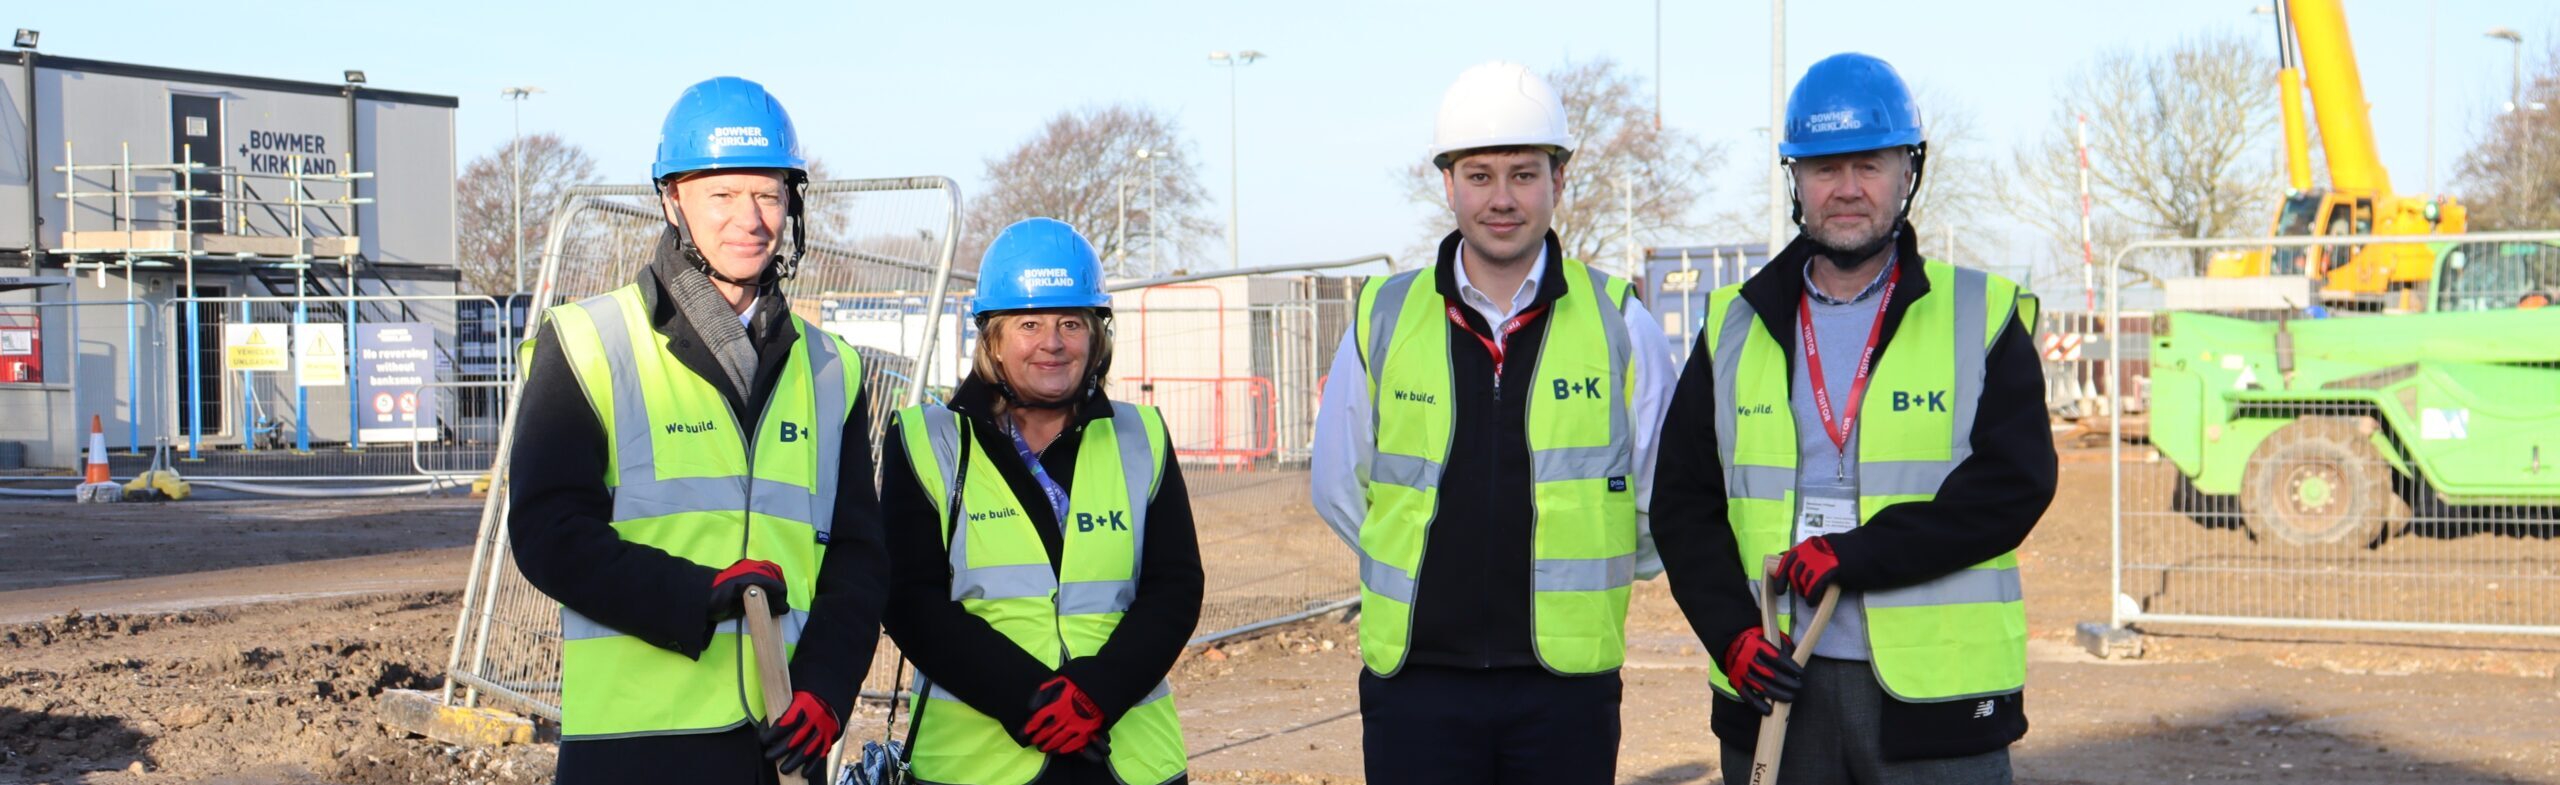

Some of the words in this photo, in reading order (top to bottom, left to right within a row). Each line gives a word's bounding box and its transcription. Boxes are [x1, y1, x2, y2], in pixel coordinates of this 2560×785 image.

[1811, 110, 1854, 123] BOWMER
[714, 126, 762, 137] BOWMER
[1811, 120, 1861, 133] KIRKLAND
[250, 130, 326, 154] BOWMER
[715, 136, 769, 147] KIRKLAND
[1024, 267, 1068, 278] BOWMER
[1804, 323, 1816, 357] VISITOR
[379, 348, 428, 361] reversing
[376, 362, 416, 373] without
[1857, 346, 1875, 379] VISITOR
[370, 376, 423, 387] banksman
[1552, 376, 1603, 400] B+K
[1394, 389, 1408, 401] We
[1410, 391, 1437, 405] build.
[1892, 390, 1947, 412] B+K
[1817, 388, 1832, 422] VISITOR
[665, 422, 684, 435] We
[686, 420, 717, 434] build.
[969, 512, 987, 522] We
[1076, 510, 1129, 533] B+K
